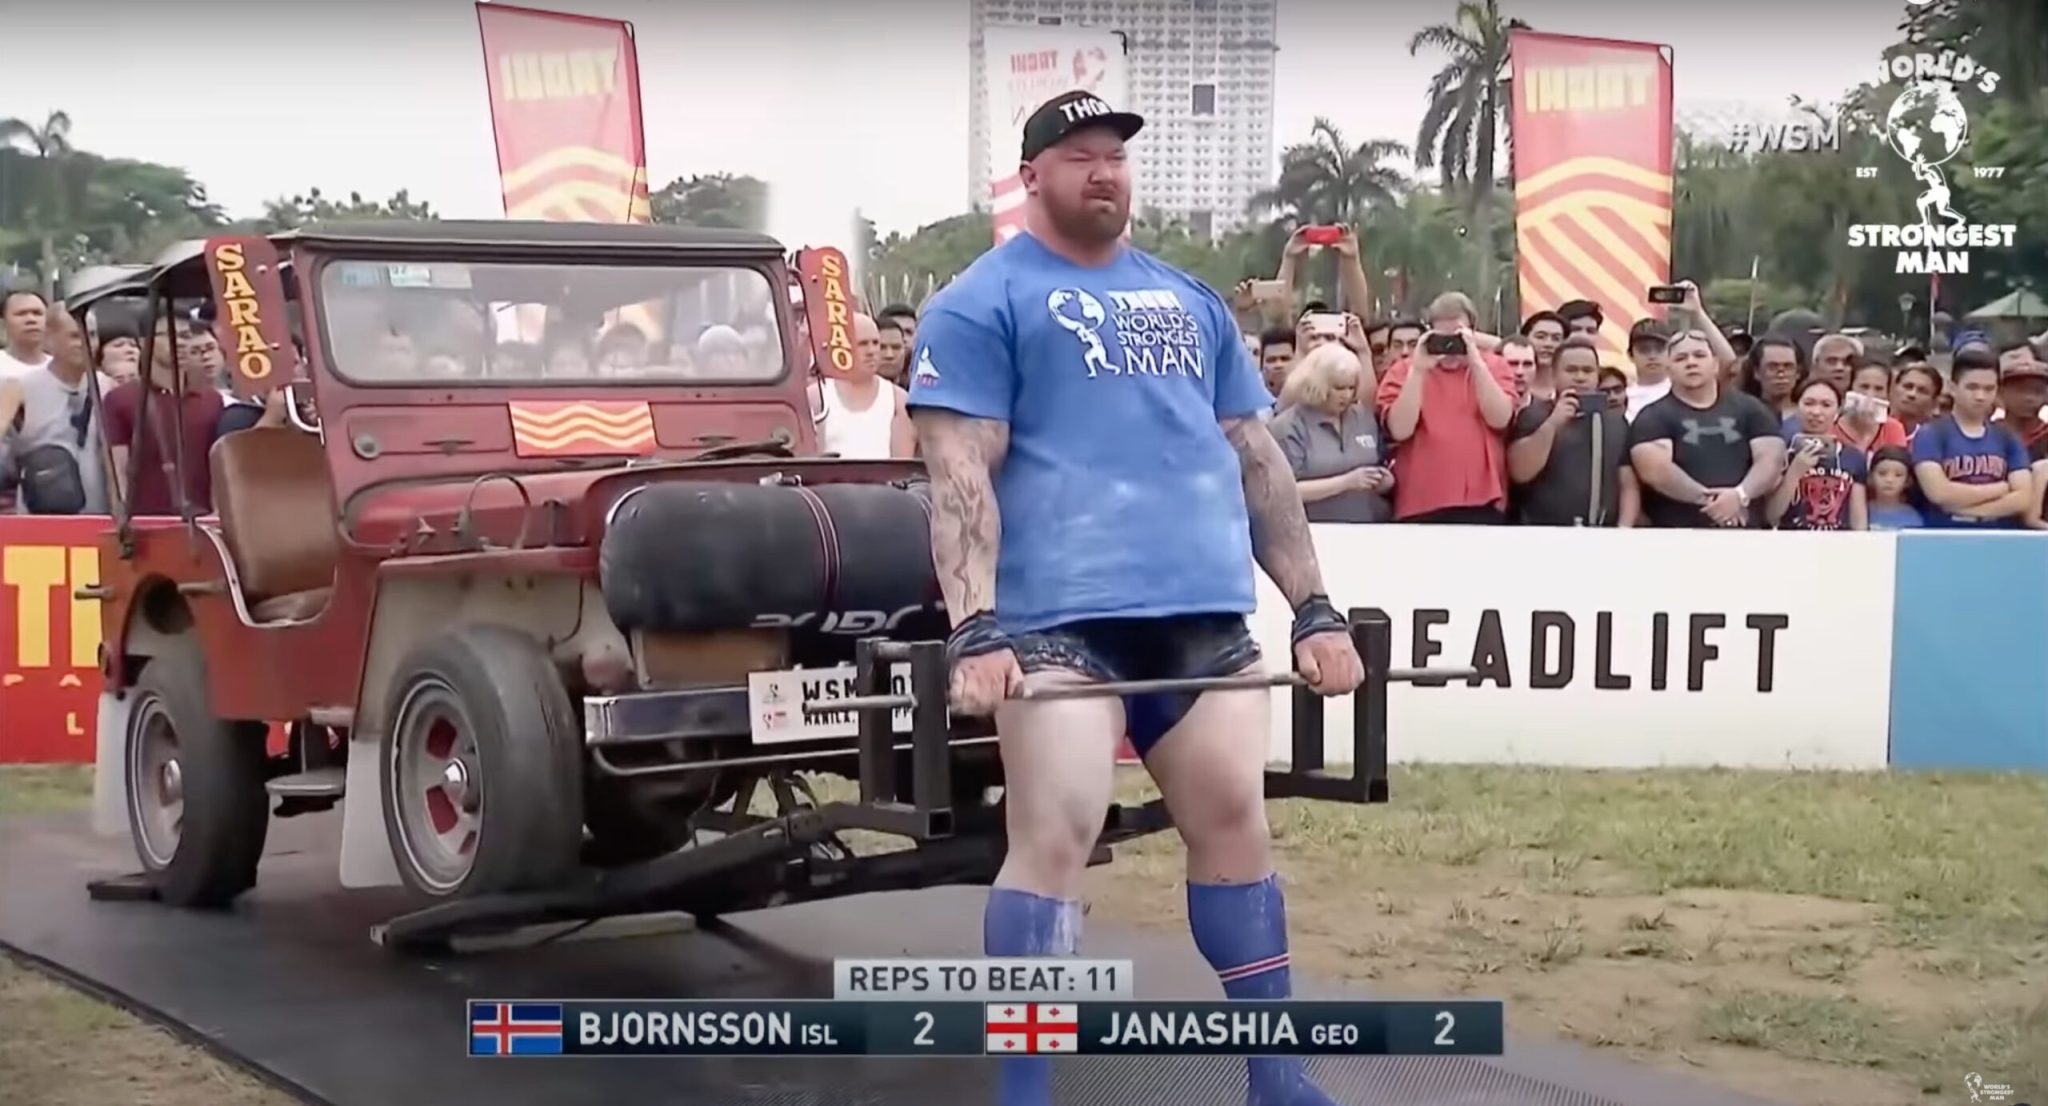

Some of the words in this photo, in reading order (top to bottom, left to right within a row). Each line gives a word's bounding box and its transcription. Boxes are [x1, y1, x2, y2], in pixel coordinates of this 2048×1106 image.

[216, 243, 272, 379] SARAO
[822, 255, 853, 371] SARAO
[1112, 313, 1199, 332] WORLD'S
[1123, 344, 1204, 379] MAN
